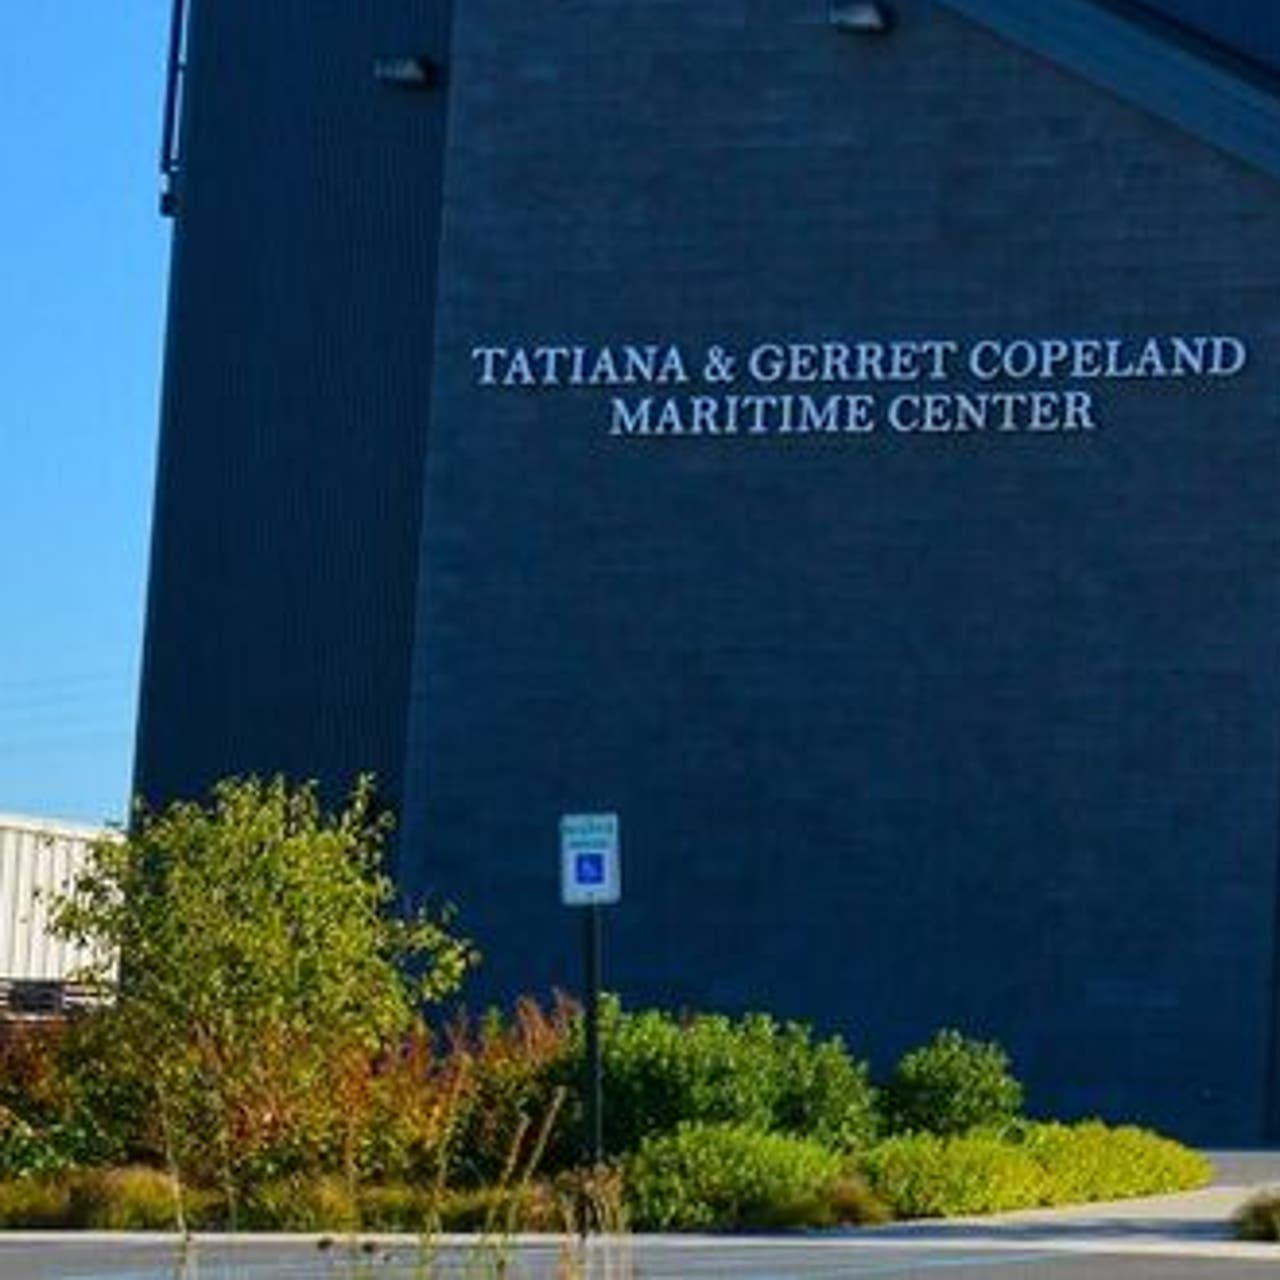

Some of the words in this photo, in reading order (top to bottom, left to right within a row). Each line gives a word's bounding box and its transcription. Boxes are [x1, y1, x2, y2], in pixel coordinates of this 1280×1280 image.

[473, 345, 688, 385] TATIANA
[704, 345, 733, 381] &
[748, 342, 956, 382] GERRET
[968, 337, 1246, 379] COPELAND
[610, 396, 875, 435] MARITIME
[887, 391, 1096, 432] CENTER
